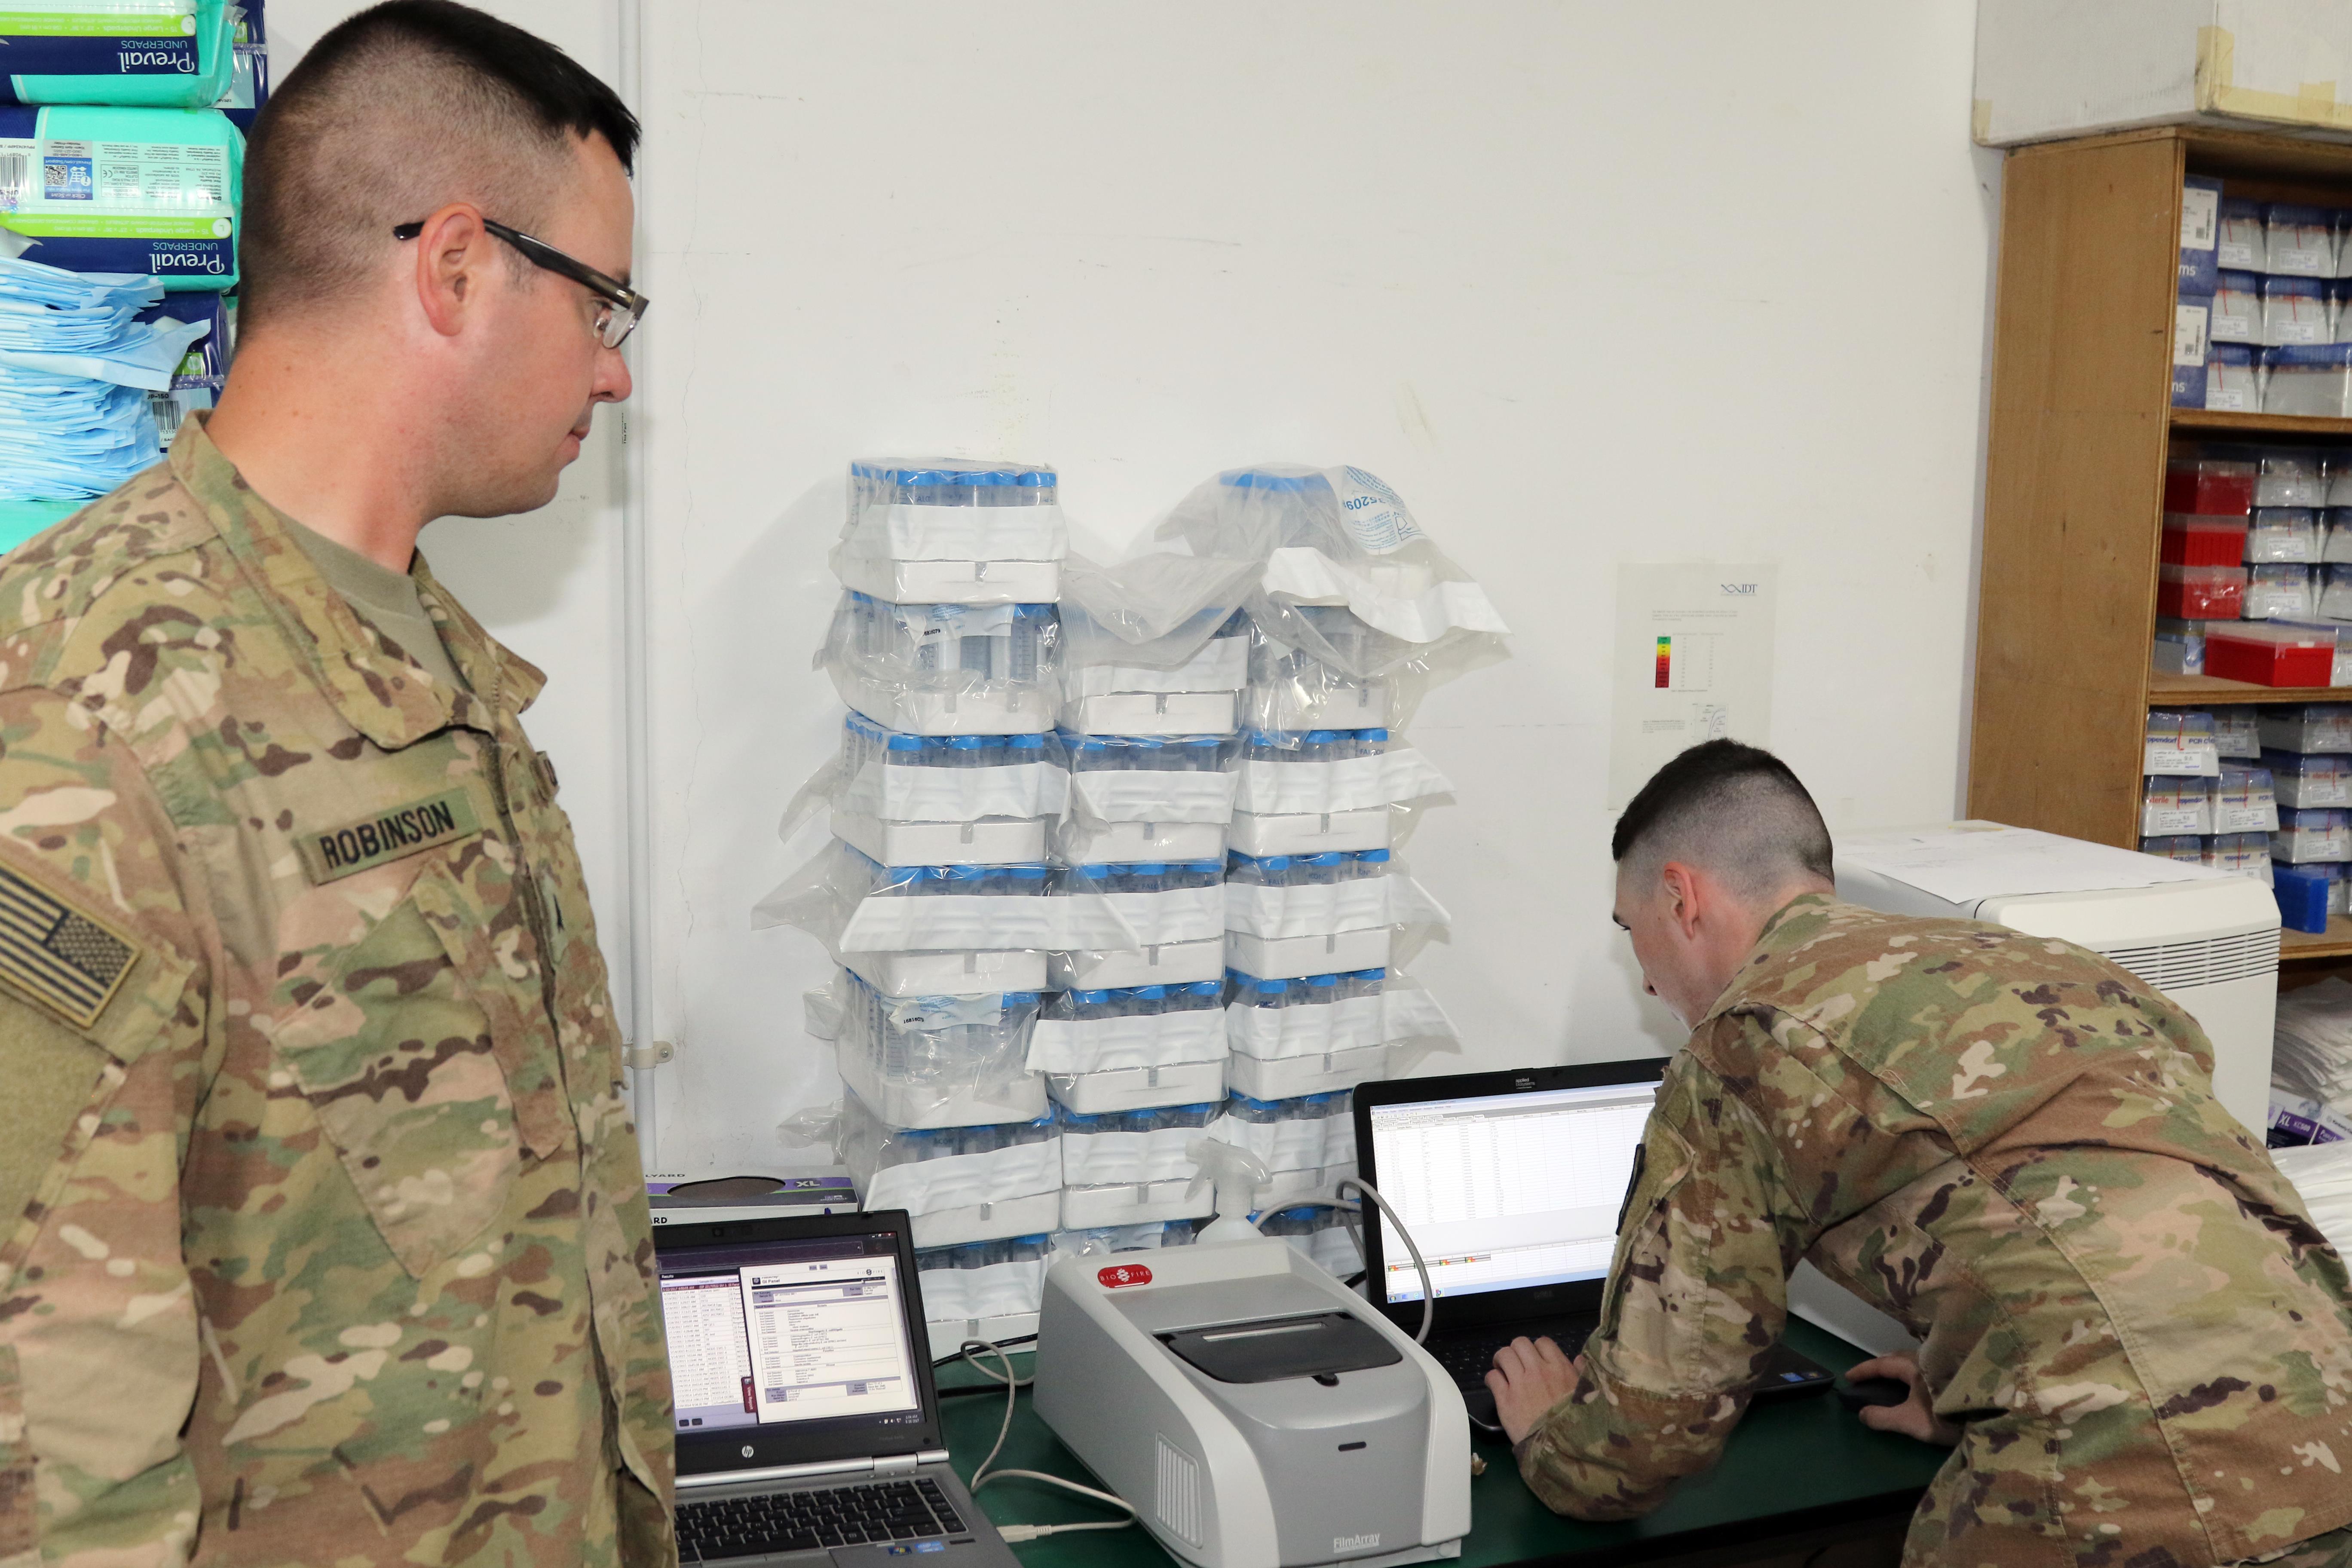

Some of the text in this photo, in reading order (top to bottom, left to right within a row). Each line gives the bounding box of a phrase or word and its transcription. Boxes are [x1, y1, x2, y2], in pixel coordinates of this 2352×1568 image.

[121, 40, 187, 49] UNDERPADS
[119, 52, 195, 73] Prevail
[153, 242, 218, 251] UNDERPADS
[150, 253, 225, 274] Prevail
[1742, 584, 1758, 593] IDT
[2149, 796, 2169, 804] sterile
[319, 800, 455, 869] ROBINSON
[2225, 853, 2250, 862] eppendorf
[2278, 1114, 2291, 1127] XL
[742, 1446, 753, 1458] hp
[1334, 1533, 1380, 1548] FilmArray
